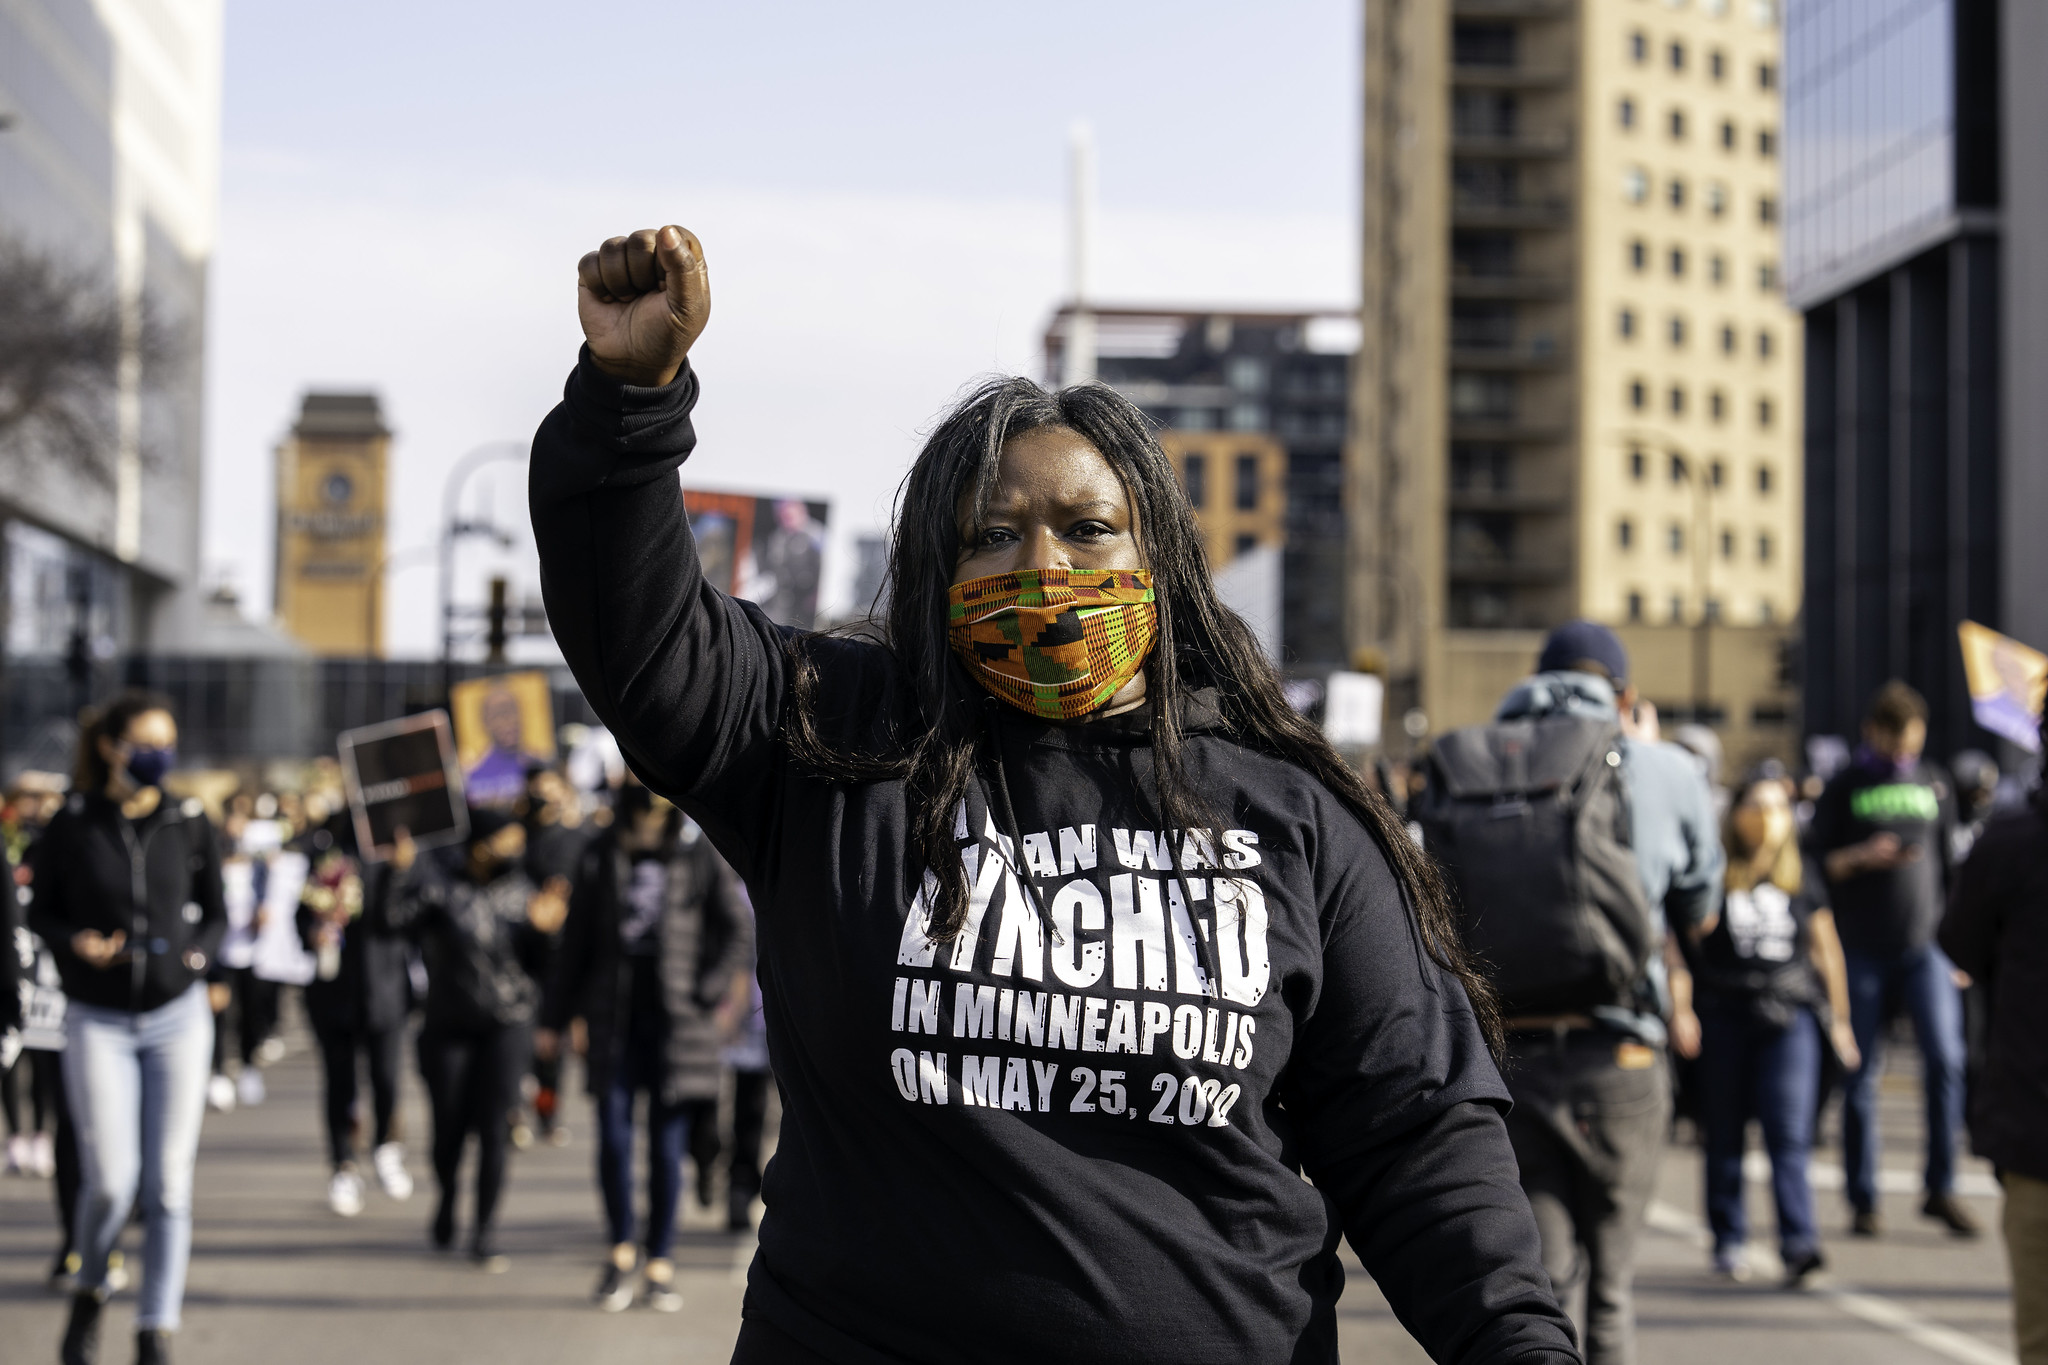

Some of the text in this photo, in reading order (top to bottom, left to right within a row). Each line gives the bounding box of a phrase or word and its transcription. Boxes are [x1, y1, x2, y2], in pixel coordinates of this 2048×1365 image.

[1111, 827, 1262, 871] WAS
[891, 977, 1256, 1070] IN MINNEAPOLIS
[890, 1048, 949, 1105] ON
[961, 1054, 1059, 1113] MAY
[1069, 1066, 1138, 1120] 25,
